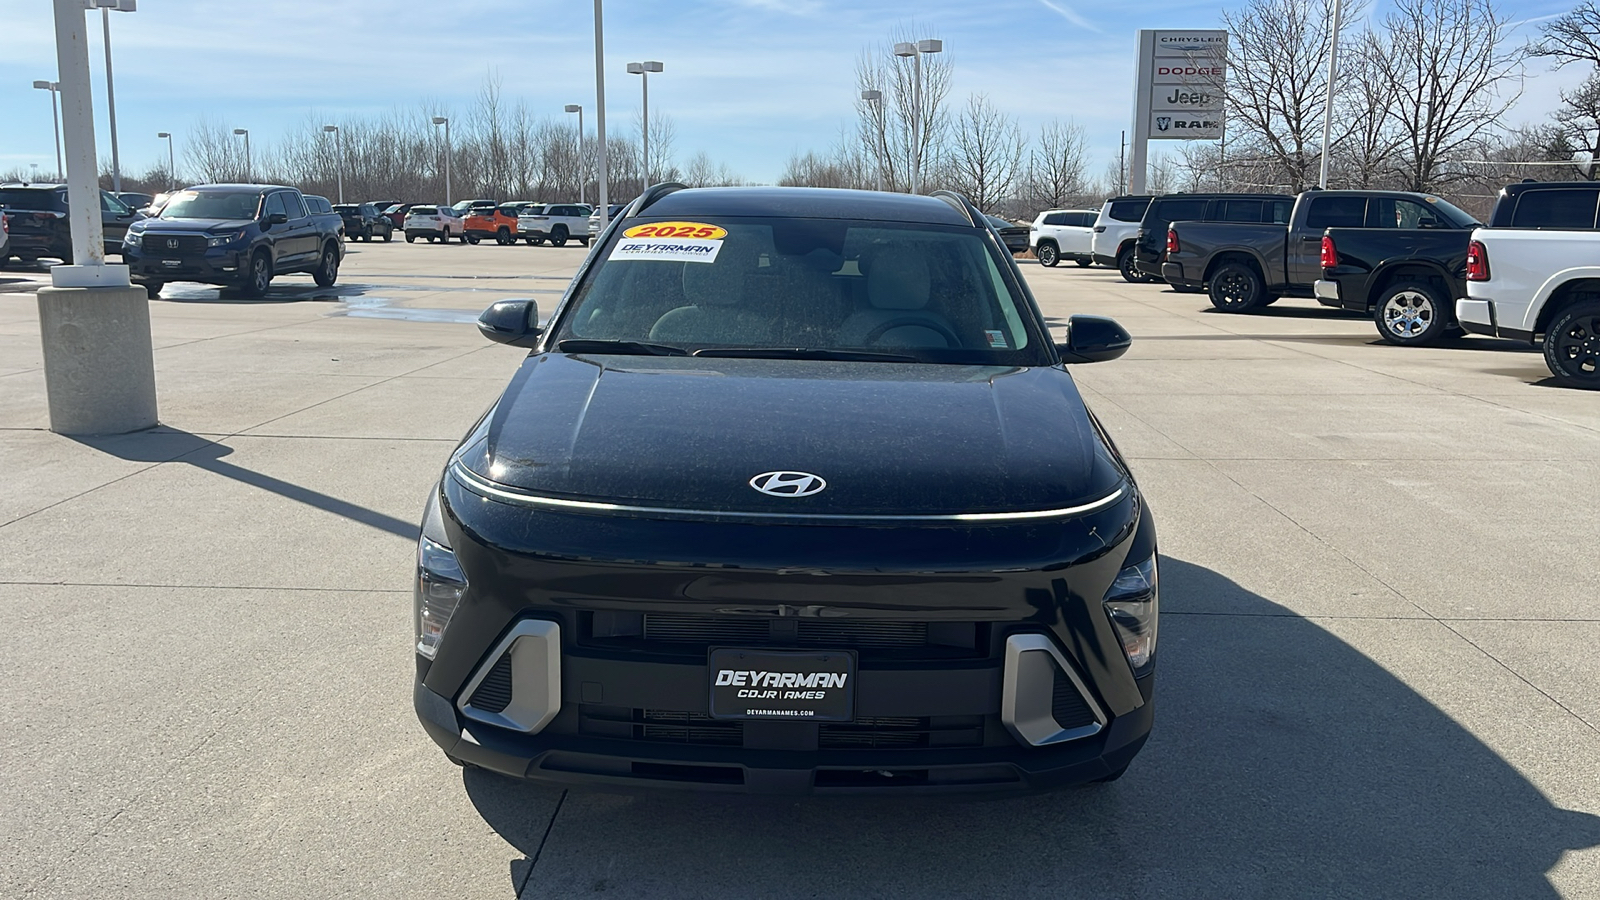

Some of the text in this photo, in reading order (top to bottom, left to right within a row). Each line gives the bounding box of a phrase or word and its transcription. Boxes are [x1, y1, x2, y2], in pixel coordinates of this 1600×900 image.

[1167, 89, 1210, 107] Jeep
[633, 226, 717, 238] 2025
[621, 244, 714, 252] DEYARMAN
[715, 670, 847, 688] DEYARMAN
[737, 690, 825, 699] CDJR AMES
[747, 709, 814, 717] DEYARMANAMES.COM
